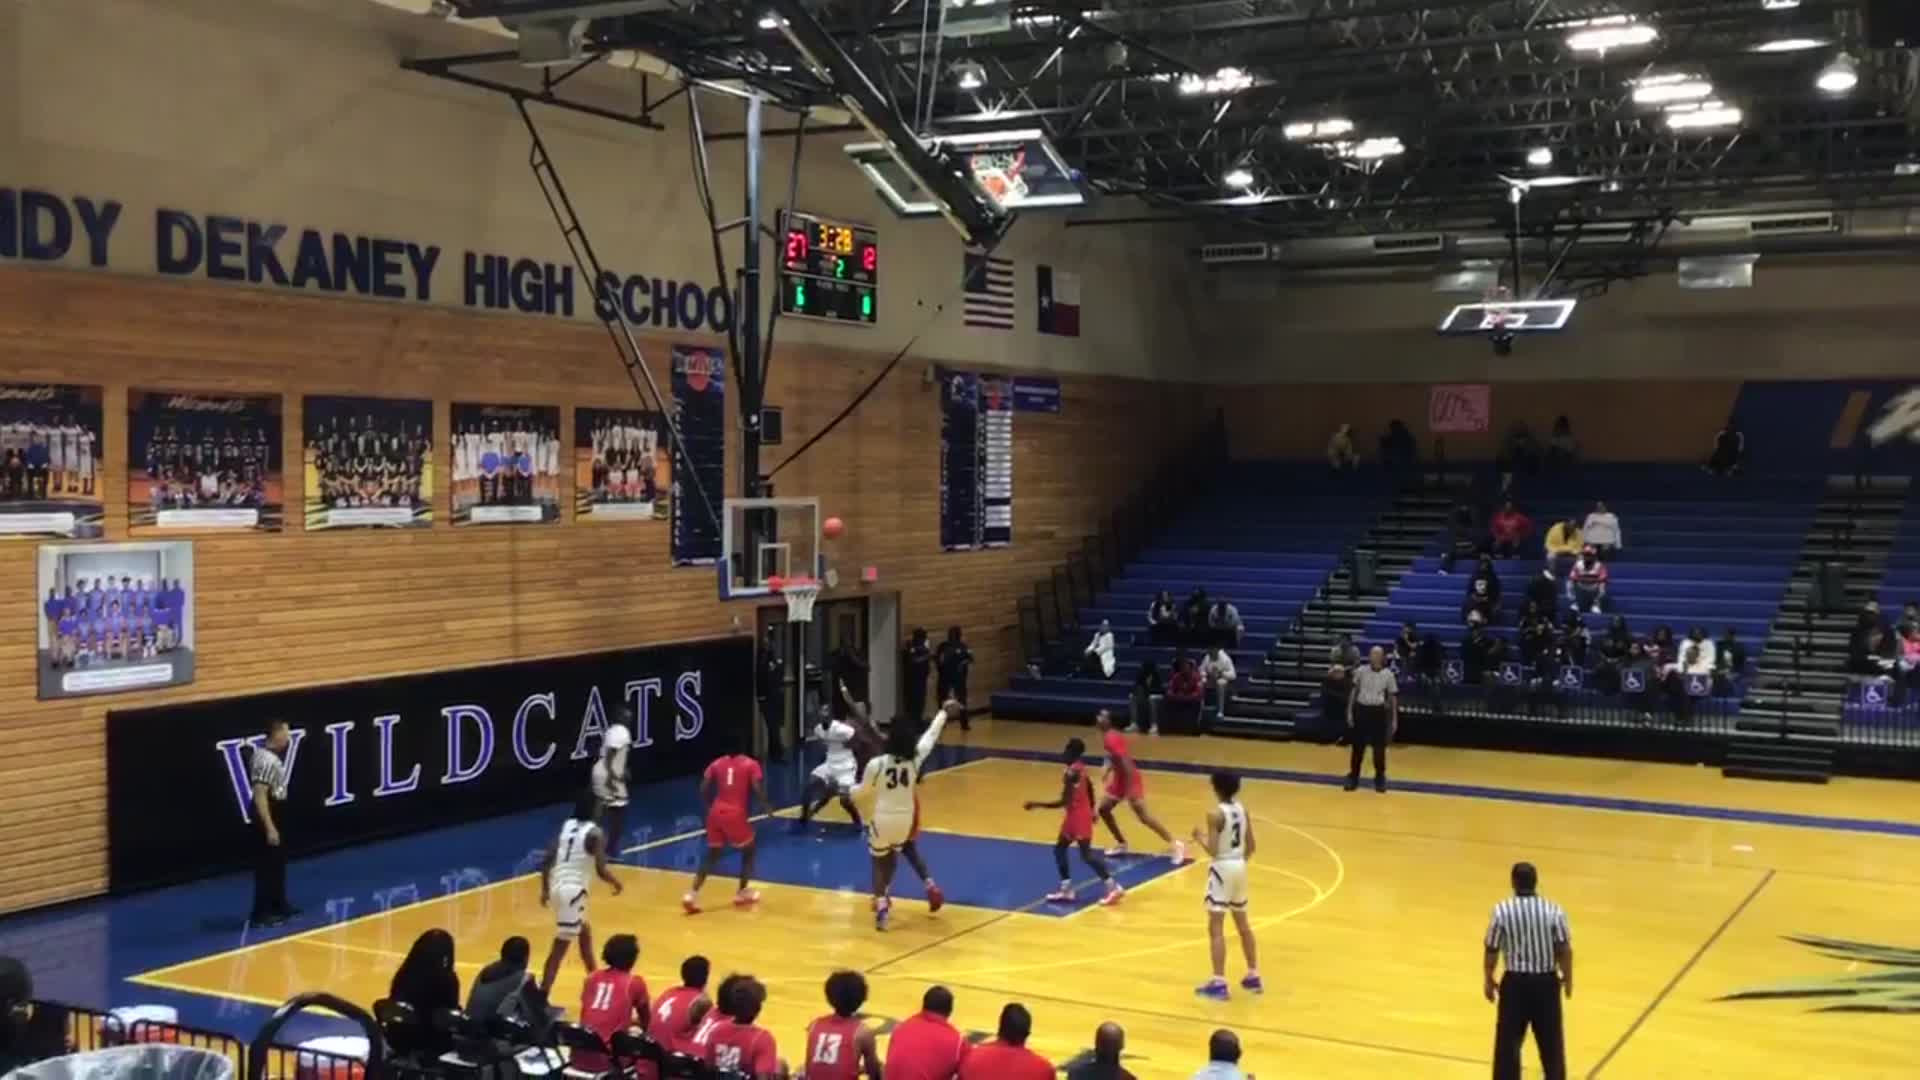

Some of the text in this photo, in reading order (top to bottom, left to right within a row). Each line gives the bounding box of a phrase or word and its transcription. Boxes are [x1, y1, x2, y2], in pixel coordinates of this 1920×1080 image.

[786, 231, 808, 259] 27
[819, 223, 853, 252] 3:28
[156, 208, 441, 301] DEKANEY
[464, 252, 574, 316] HIGH
[594, 269, 746, 333] SCHOO
[835, 259, 846, 278] 2
[216, 670, 705, 824] WILDCATS
[726, 767, 734, 786] 1
[884, 767, 910, 790] 34
[1231, 821, 1241, 849] 3
[591, 982, 615, 1011] 11
[812, 1032, 843, 1065] 13
